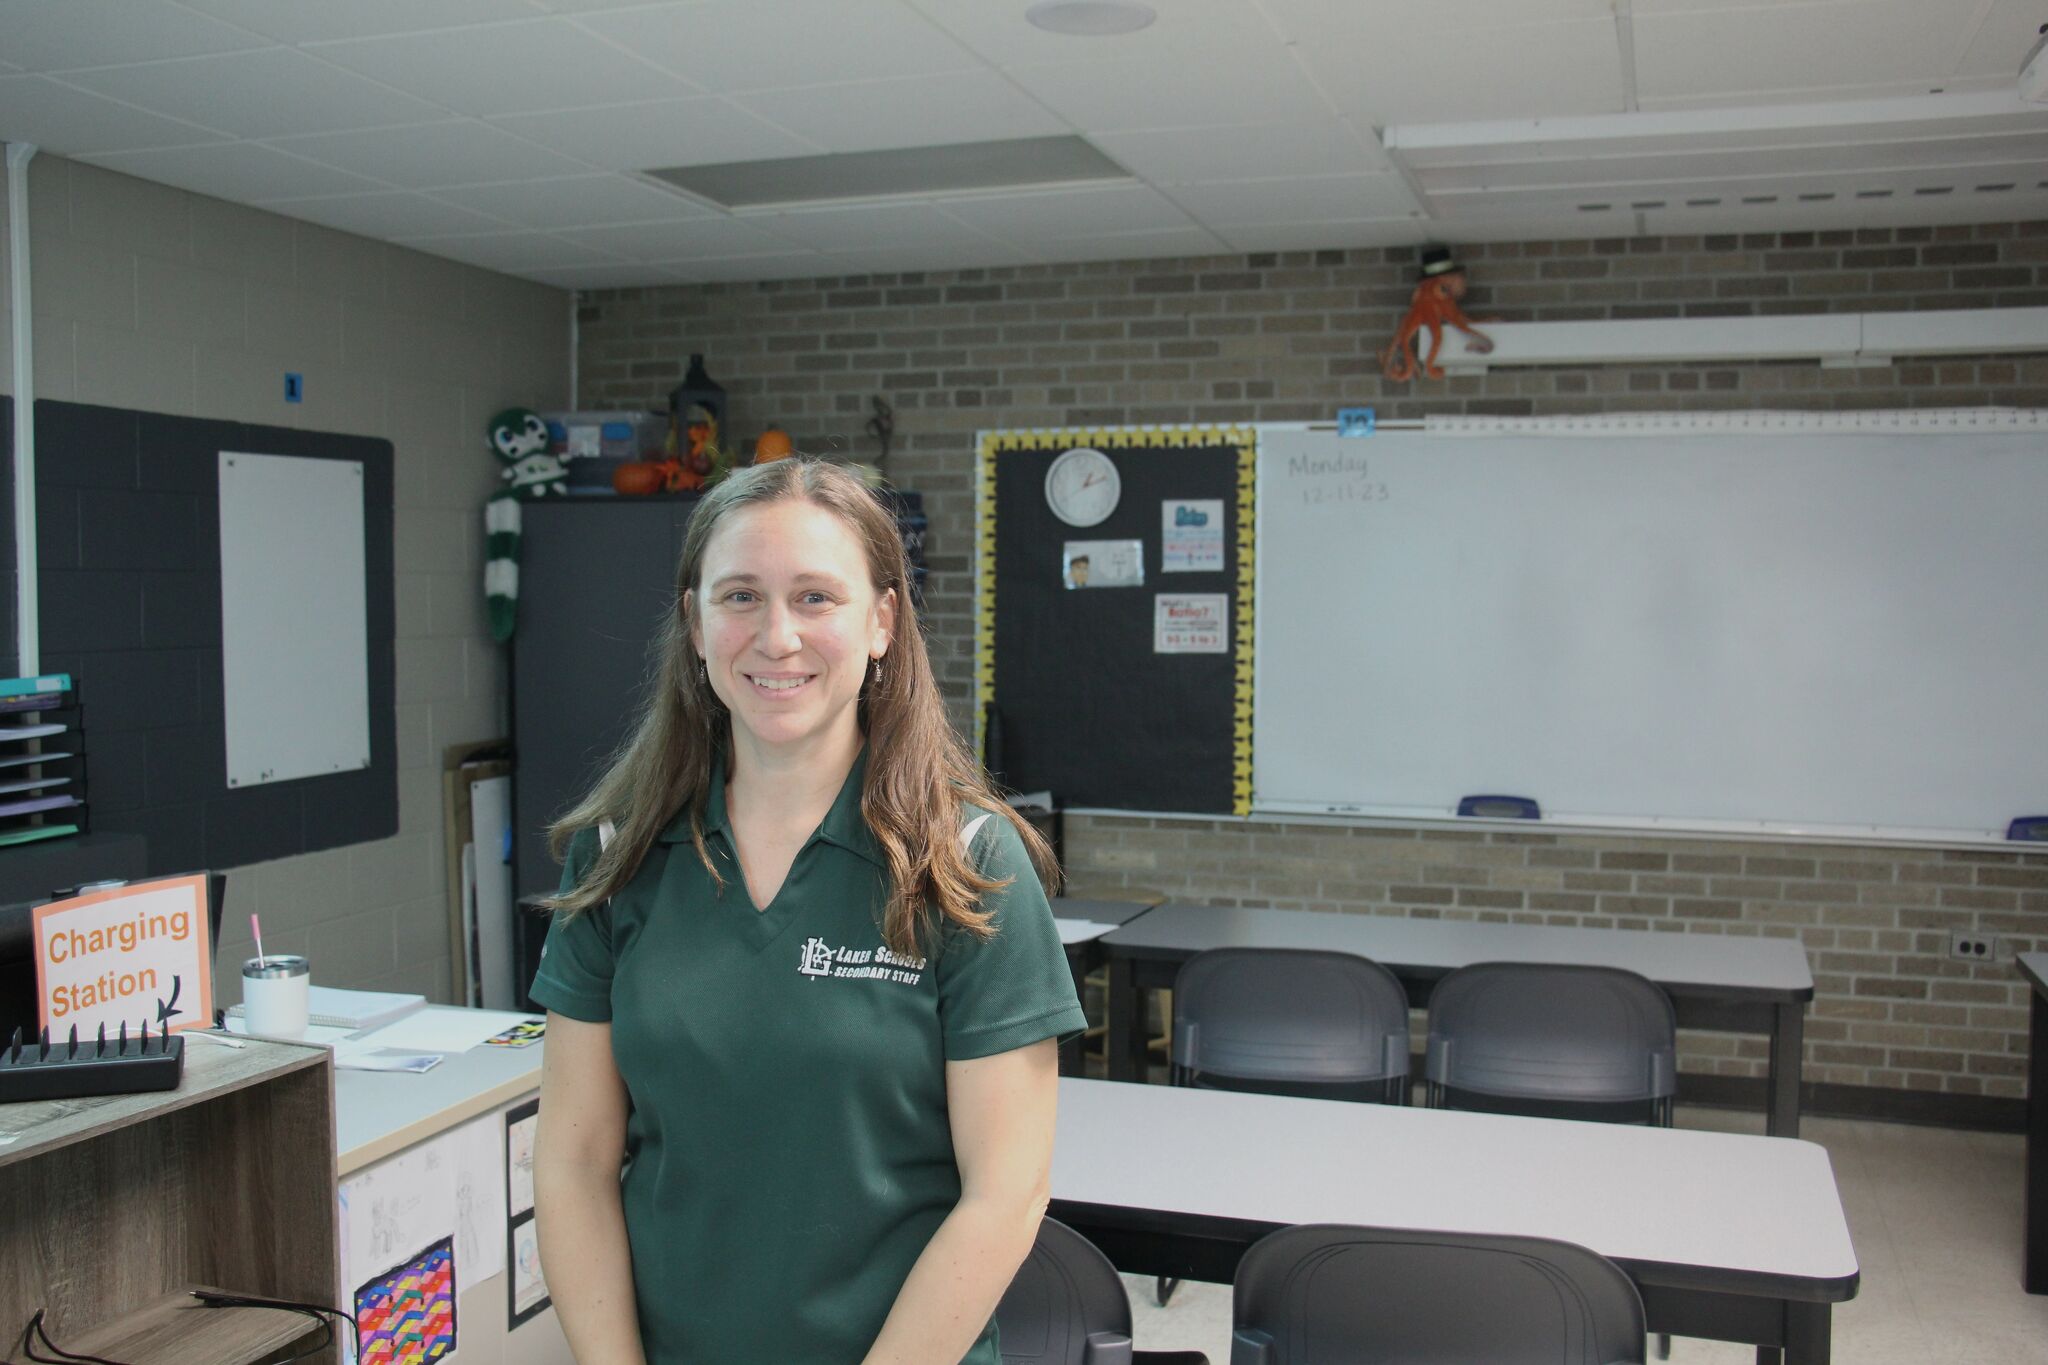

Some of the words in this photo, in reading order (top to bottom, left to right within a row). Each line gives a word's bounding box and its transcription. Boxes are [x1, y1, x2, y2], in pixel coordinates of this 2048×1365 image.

[1288, 451, 1368, 479] Monday
[49, 910, 190, 964] Charging
[836, 945, 872, 964] LAKER
[834, 966, 892, 980] SECONDARY
[891, 969, 920, 985] STAFF
[52, 968, 158, 1018] Station
